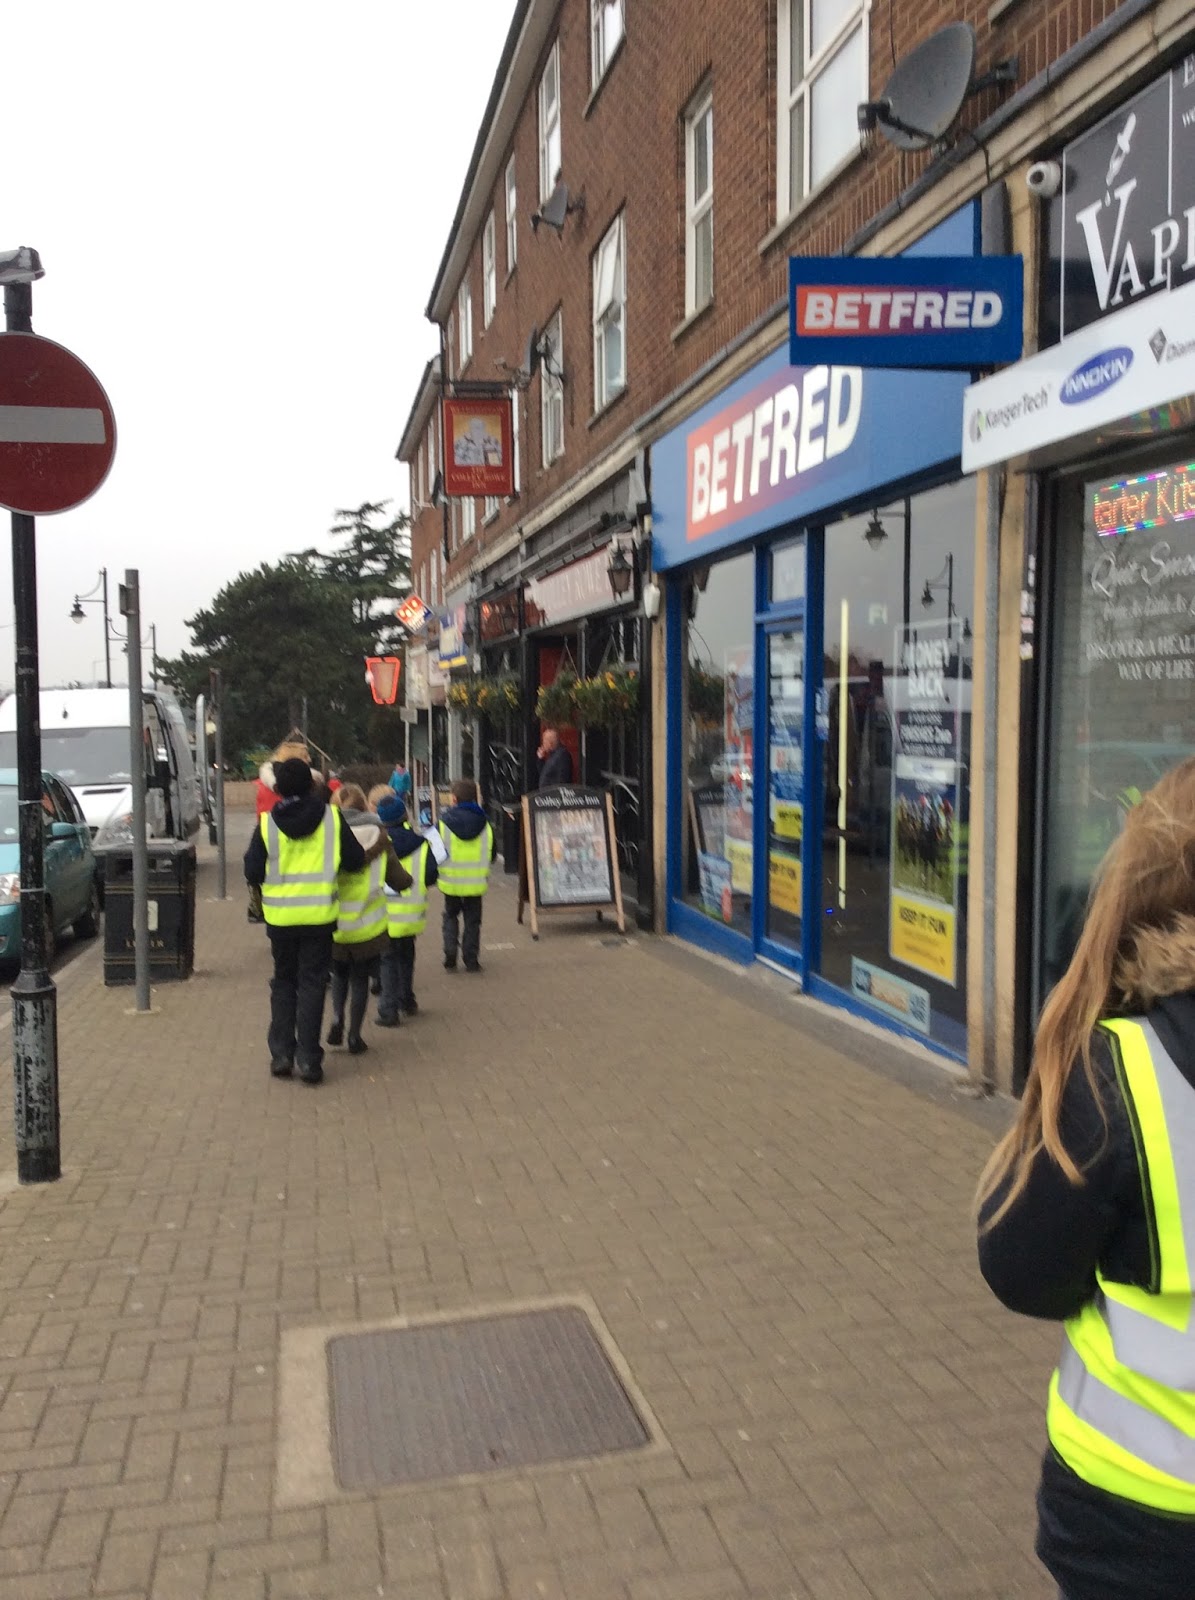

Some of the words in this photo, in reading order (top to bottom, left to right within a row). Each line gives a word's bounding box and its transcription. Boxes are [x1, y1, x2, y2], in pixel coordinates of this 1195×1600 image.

[803, 290, 1003, 330] BETFRED
[1065, 355, 1128, 397] INNOKIN
[691, 364, 864, 524] BETFRED
